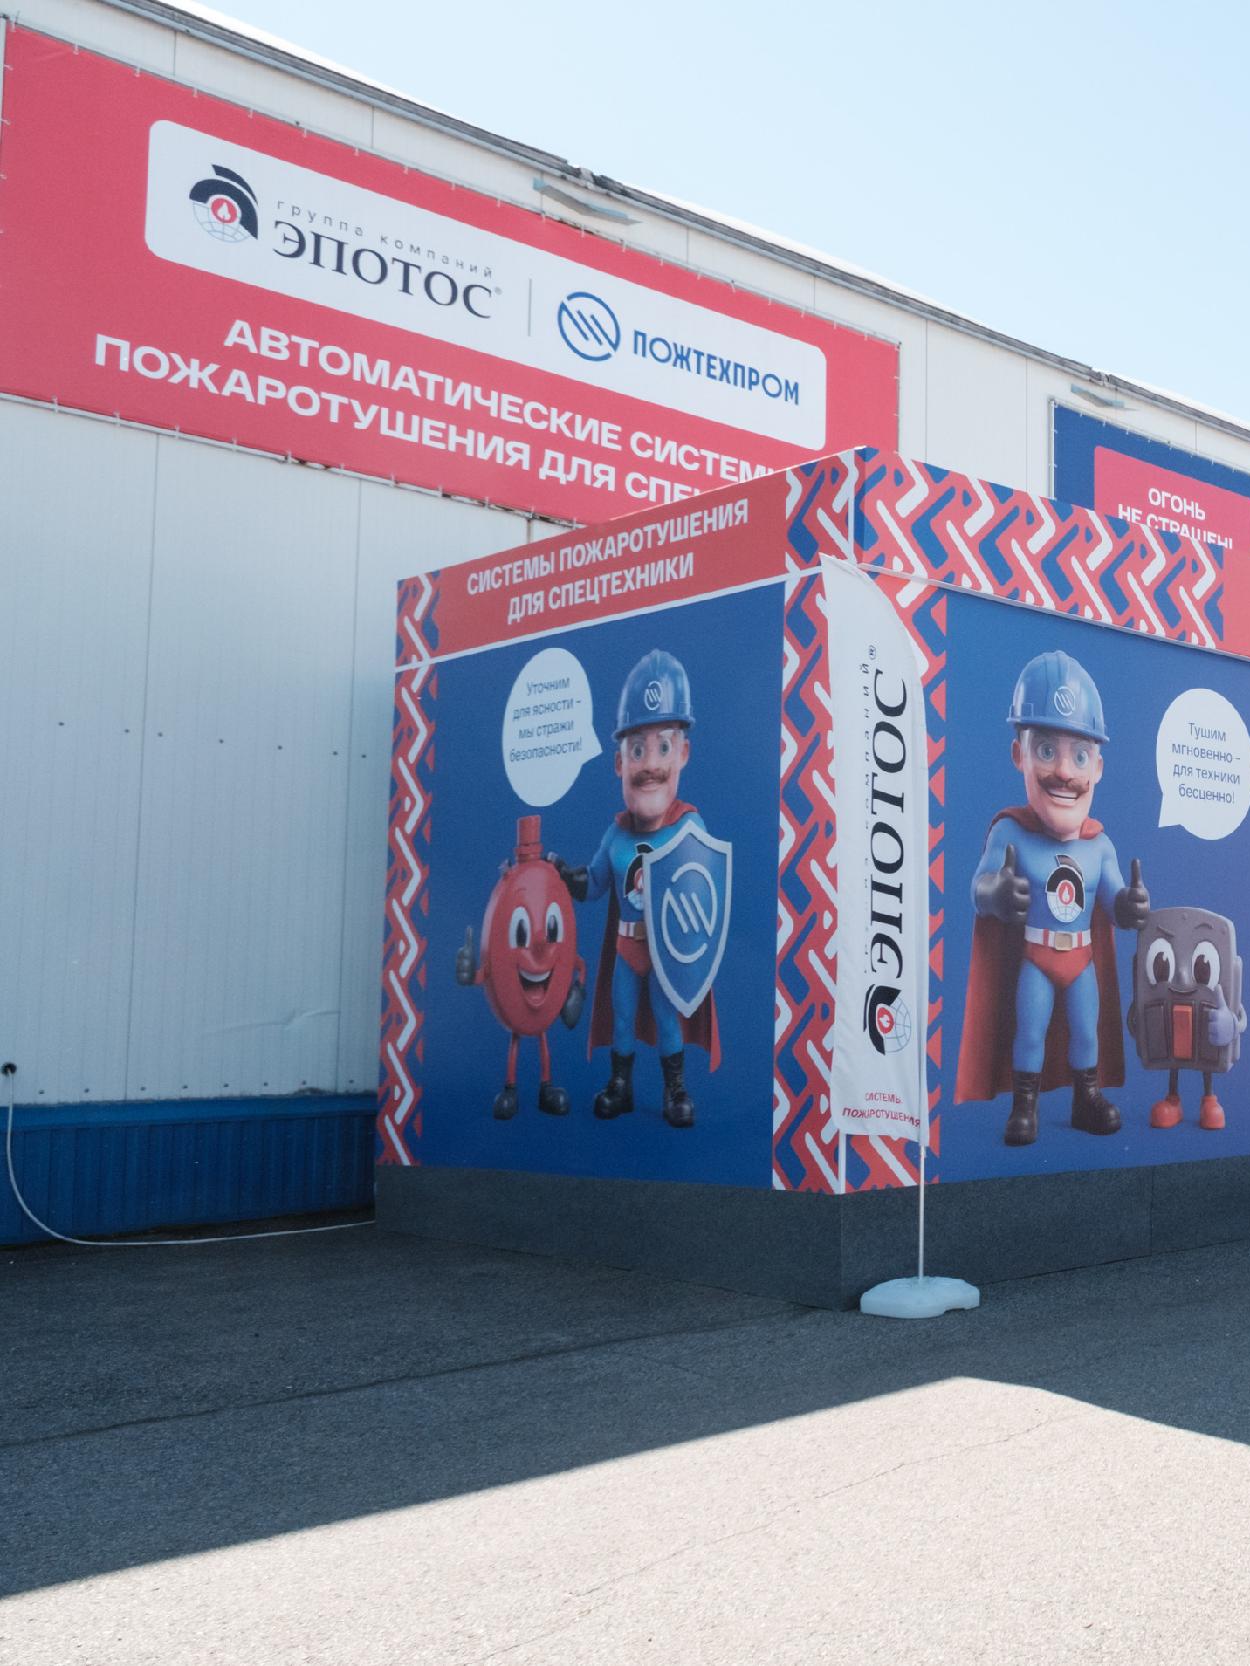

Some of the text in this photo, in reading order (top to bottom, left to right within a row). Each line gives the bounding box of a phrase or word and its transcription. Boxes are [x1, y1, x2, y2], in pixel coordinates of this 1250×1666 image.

[277, 200, 493, 279] группа компаний
[633, 329, 800, 405] ПОЖТЕХПРОМ
[224, 319, 777, 483] АВТОМАТИЧЕСКИЕ СИСТЕМ
[95, 333, 702, 505] ПОЖАРОТУШЕНИЯ ДЛЯ СПЕ
[1118, 504, 1143, 524] НЕ
[1148, 488, 1206, 521] ОГОНЬ
[467, 498, 749, 596] СИСТЕМЫ ПОЖАРОТУШЕНИЯ
[507, 551, 695, 626] ДЛЯ СПЕЦТЕХНИКИ
[526, 677, 570, 697] Уточним
[513, 707, 531, 720] для
[533, 698, 574, 717] ясности
[518, 720, 574, 739] мы стражи
[1188, 722, 1227, 742] Тушим
[509, 736, 583, 763] безопасности!
[1171, 743, 1233, 764] мгновенно
[1173, 764, 1241, 785] для техники
[1178, 784, 1235, 804] бесценно!
